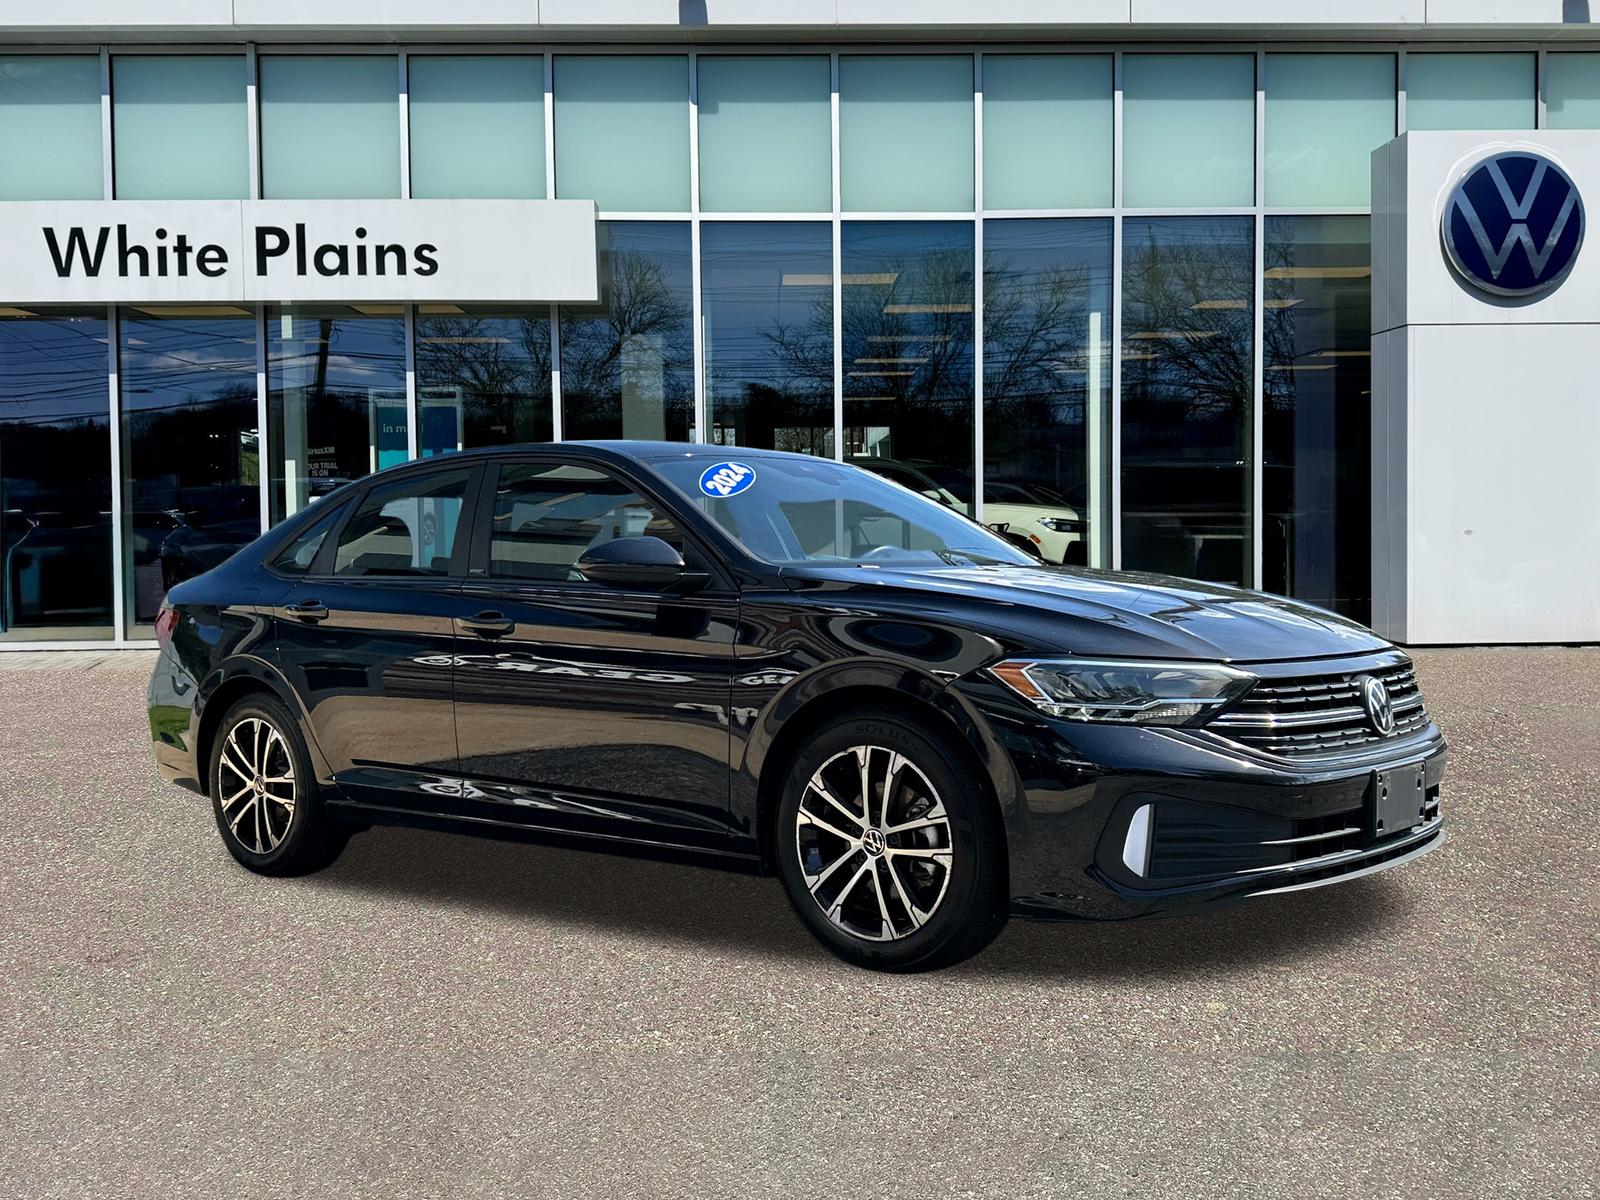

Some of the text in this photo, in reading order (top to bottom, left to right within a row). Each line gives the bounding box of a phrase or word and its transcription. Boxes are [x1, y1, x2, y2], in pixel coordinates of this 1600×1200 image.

[1453, 156, 1578, 281] VW
[42, 223, 439, 278] White Plains
[706, 463, 751, 495] 2024
[855, 724, 912, 745] SOLUS
